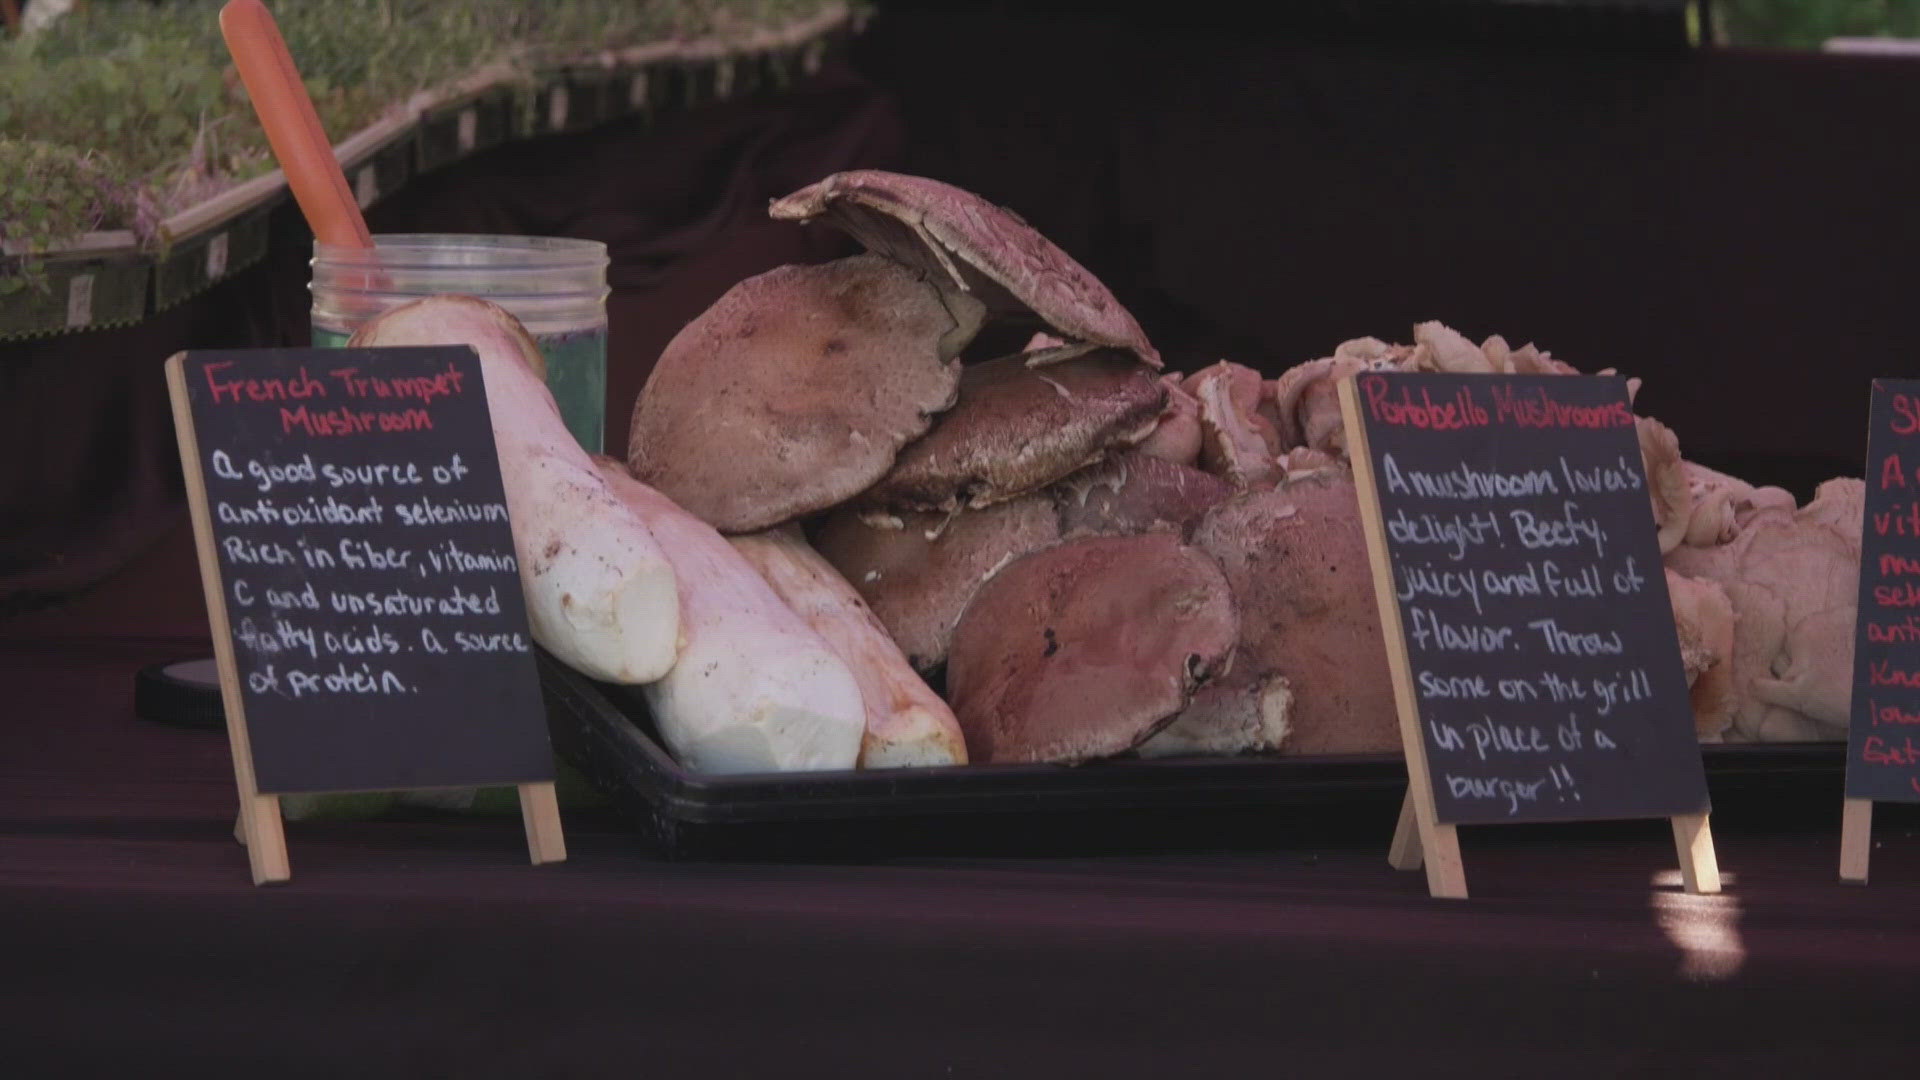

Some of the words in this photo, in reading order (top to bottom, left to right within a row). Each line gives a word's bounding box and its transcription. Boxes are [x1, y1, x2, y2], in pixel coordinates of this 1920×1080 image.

[204, 362, 326, 404] French
[330, 362, 464, 403] Trumpet
[281, 406, 432, 437] Mushroom
[1491, 384, 1634, 428] Mushrooms
[248, 454, 315, 491] good
[323, 463, 422, 487] source
[433, 453, 468, 483] of
[1382, 453, 1410, 495] A
[1410, 461, 1557, 499] mushroom
[1881, 453, 1905, 489] A
[218, 497, 382, 526] antioxidant
[396, 499, 508, 527] selenium
[224, 536, 296, 565] Rich
[298, 538, 336, 568] in
[428, 539, 519, 573] vitamin
[1483, 562, 1541, 597] and
[1543, 560, 1603, 597] full
[1613, 555, 1645, 594] of
[234, 580, 255, 606] C
[266, 581, 320, 611] and
[331, 585, 500, 615] unsaturated
[235, 616, 316, 657] fatty
[454, 631, 528, 653] source
[1411, 606, 1519, 651] flavor.
[1528, 619, 1622, 655] Throw
[249, 664, 280, 694] of
[1418, 669, 1490, 698] some
[1499, 679, 1537, 701] on
[1540, 671, 1586, 700] the
[1594, 667, 1652, 715] grill
[1430, 714, 1464, 750] in
[1467, 715, 1549, 760] place
[1558, 712, 1582, 749] of
[1595, 728, 1616, 750] a
